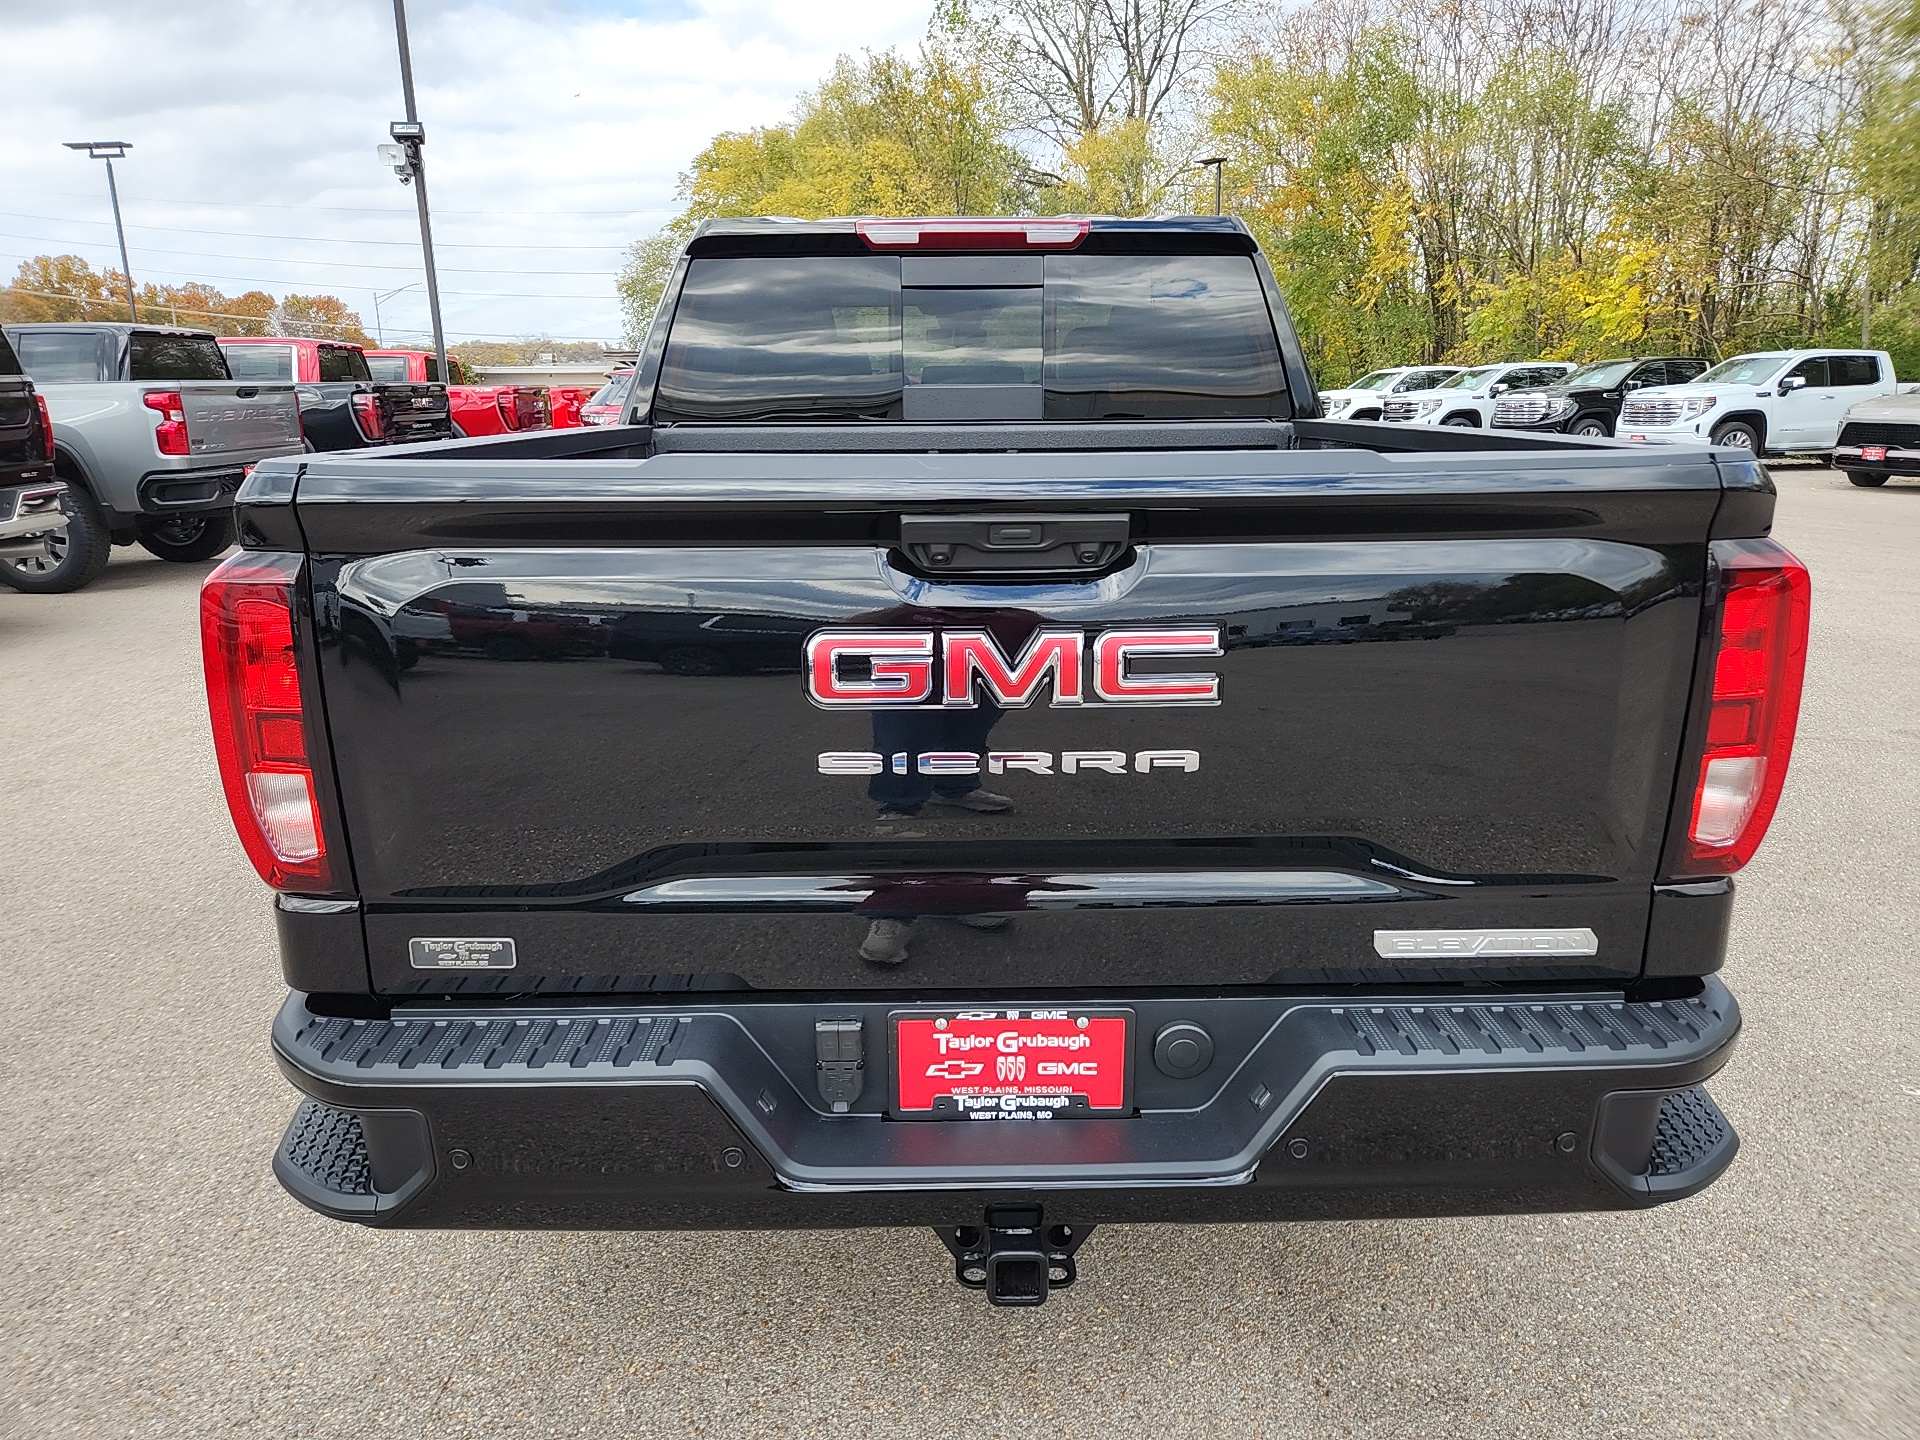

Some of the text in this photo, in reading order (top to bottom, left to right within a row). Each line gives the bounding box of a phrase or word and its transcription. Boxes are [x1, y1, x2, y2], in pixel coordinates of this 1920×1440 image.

[803, 627, 1224, 710] GMC
[817, 749, 1201, 776] SIERRA
[420, 941, 503, 953] Taylor Grubaugh
[1391, 935, 1583, 951] ELEVATION
[1031, 1010, 1068, 1020] GMC
[932, 1031, 1091, 1055] Taylor Grubaugh
[1037, 1062, 1098, 1075] GMC
[950, 1086, 1074, 1095] WEST PLAINS, MISSOURI
[952, 1094, 1070, 1112] Taylor Grubaugh
[969, 1111, 1053, 1120] WEST PLAINS, MO
